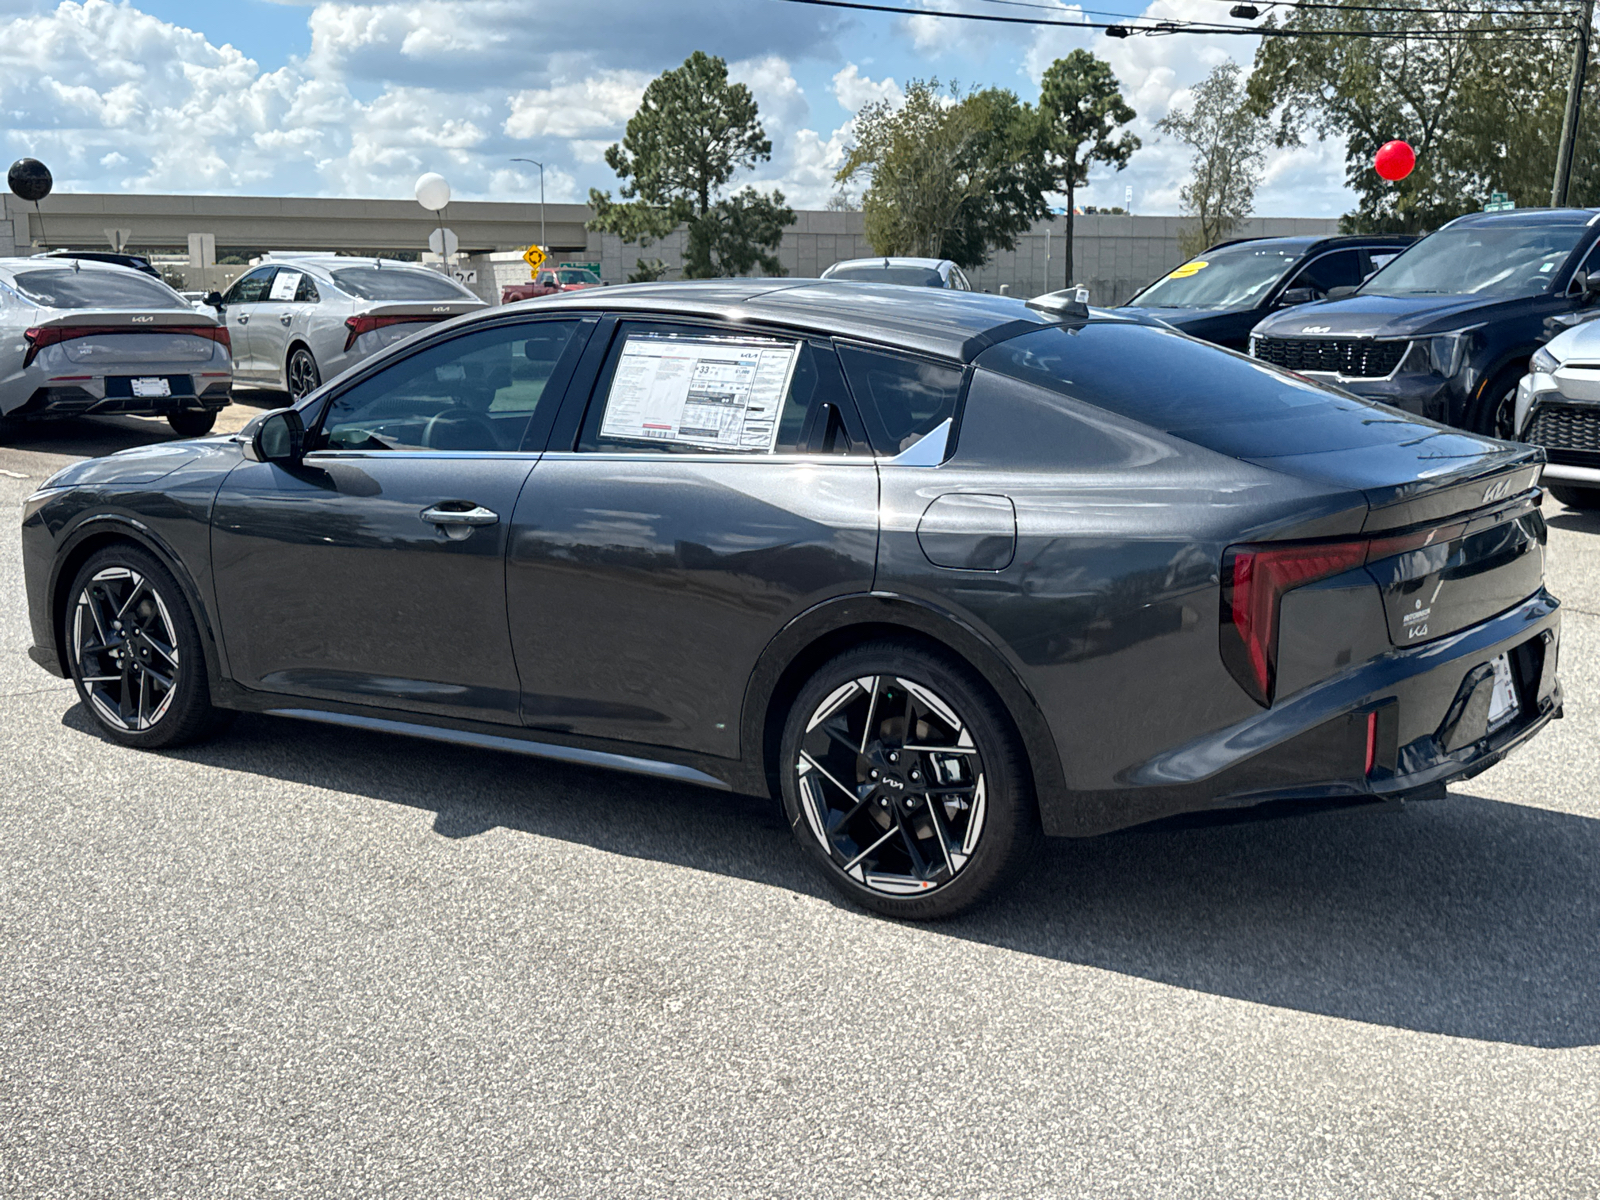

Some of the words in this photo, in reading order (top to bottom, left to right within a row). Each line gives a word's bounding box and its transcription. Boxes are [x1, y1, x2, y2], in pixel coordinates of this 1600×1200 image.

[699, 365, 710, 374] 33
[1482, 478, 1511, 503] KIA
[882, 776, 904, 790] KIA
